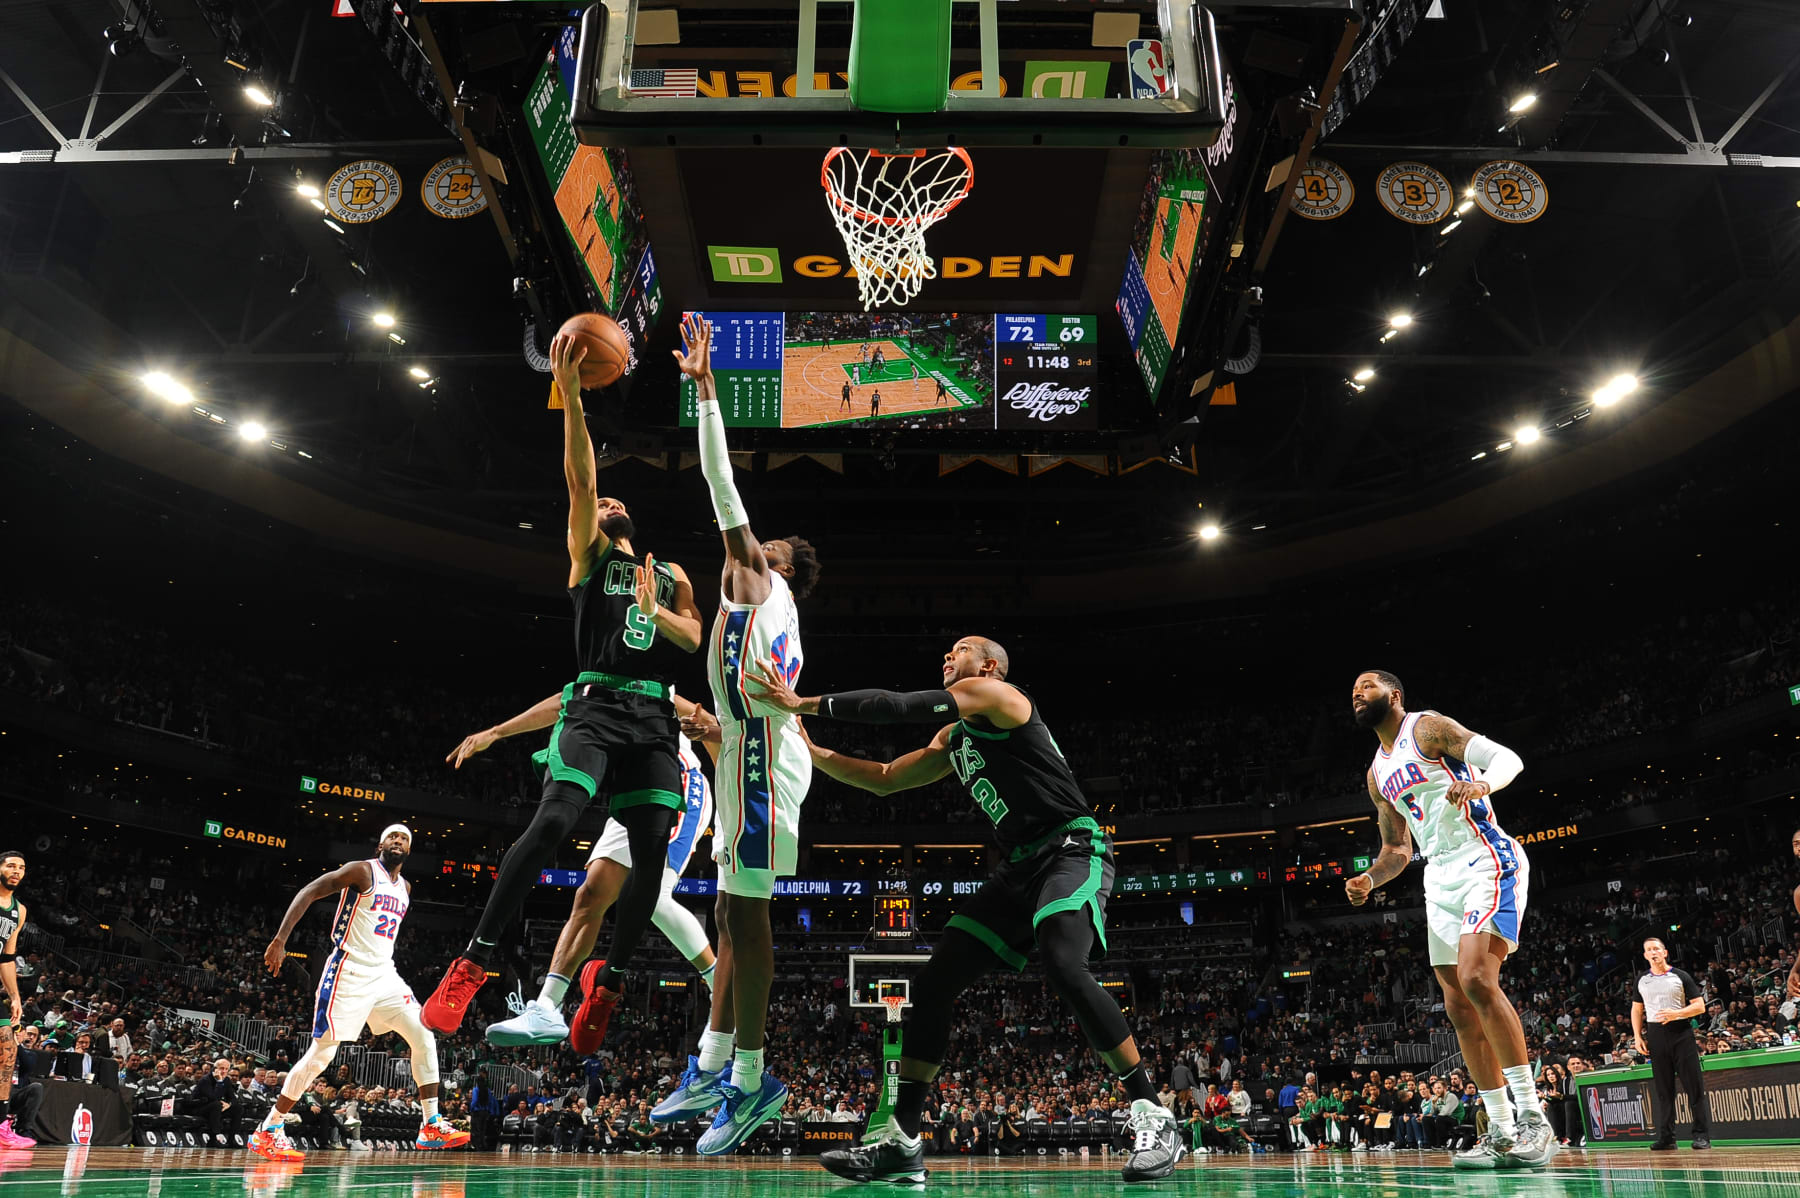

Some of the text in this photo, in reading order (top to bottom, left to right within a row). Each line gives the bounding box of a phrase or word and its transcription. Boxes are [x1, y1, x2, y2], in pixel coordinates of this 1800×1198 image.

[329, 164, 360, 198] RAYMOND
[373, 163, 398, 196] BOURQUE
[1328, 166, 1345, 182] ORR
[1380, 165, 1448, 192] LIONEL HITCHMAN
[1476, 164, 1499, 192] EDWARD
[1514, 166, 1541, 190] SHORE
[354, 187, 373, 197] 77
[451, 182, 470, 193] 24
[1308, 180, 1324, 196] 4
[1407, 185, 1422, 201] 3
[1502, 184, 1519, 200] 2
[337, 206, 385, 220] 1979-2000
[1494, 207, 1537, 220] 1926-1940
[715, 252, 774, 276] TD
[1009, 326, 1084, 342] 72 69
[1027, 356, 1069, 369] 11:48
[1001, 382, 1091, 409] Different
[1028, 400, 1080, 421] Here
[622, 603, 657, 651] 9
[302, 778, 385, 801] TD GARDEN
[1381, 762, 1428, 802] PHILA
[1401, 792, 1425, 822] 5
[206, 822, 287, 848] TD GARDEN
[1514, 824, 1578, 846] GARDEN
[1354, 859, 1369, 869] TD
[568, 877, 578, 885] 19
[773, 882, 831, 894] HILADELPHIA
[842, 882, 862, 895] 72
[923, 882, 943, 895] 69
[1123, 883, 1143, 891] 12/22
[1152, 881, 1160, 889] 11
[1171, 880, 1177, 888] 5
[1463, 910, 1480, 925] 76
[374, 914, 398, 940] 22
[1600, 1094, 1645, 1132] TOURNAMENT
[1709, 1088, 1751, 1123] ROUNDS
[1752, 1085, 1787, 1121] BEGIN
